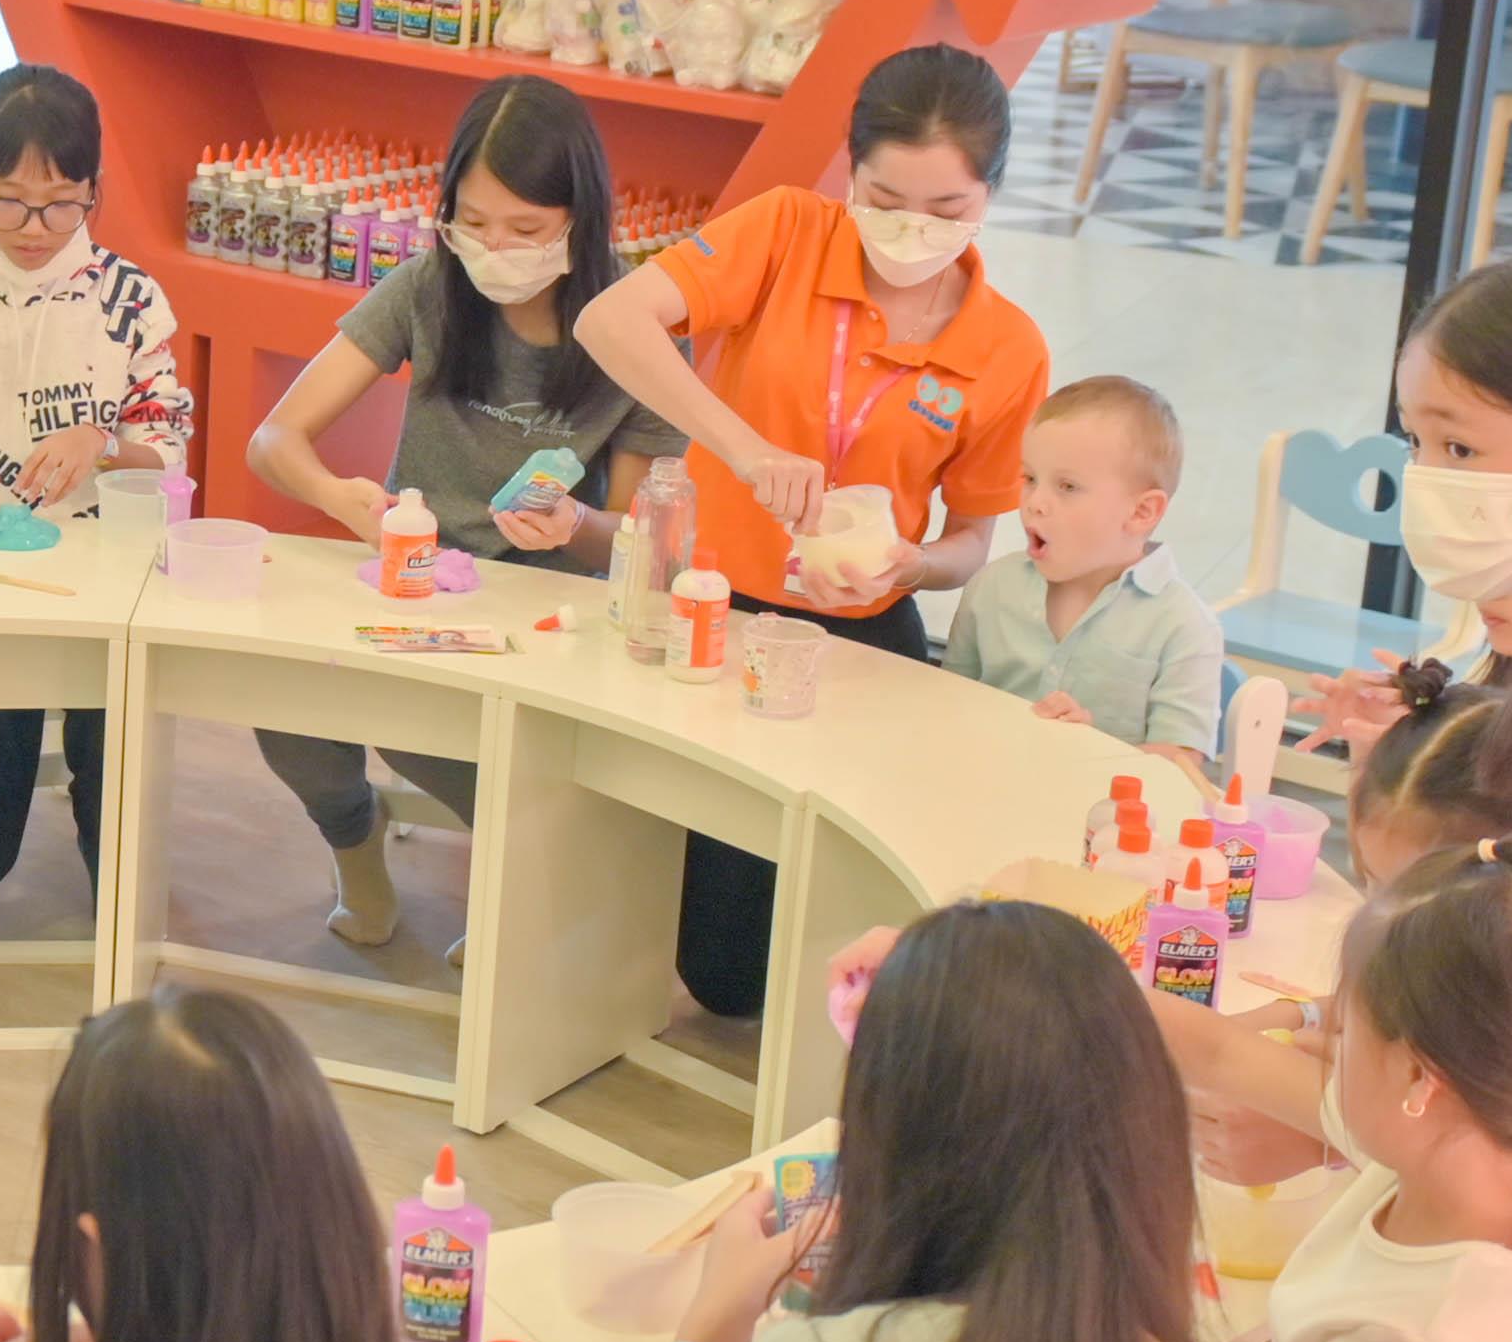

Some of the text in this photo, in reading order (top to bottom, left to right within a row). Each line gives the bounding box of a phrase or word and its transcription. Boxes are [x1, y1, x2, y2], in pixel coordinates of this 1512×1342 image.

[18, 382, 93, 406] TOMMY
[26, 400, 118, 433] HILFIG
[1160, 943, 1216, 957] ELMER'S
[405, 1244, 472, 1265] ELMER'S
